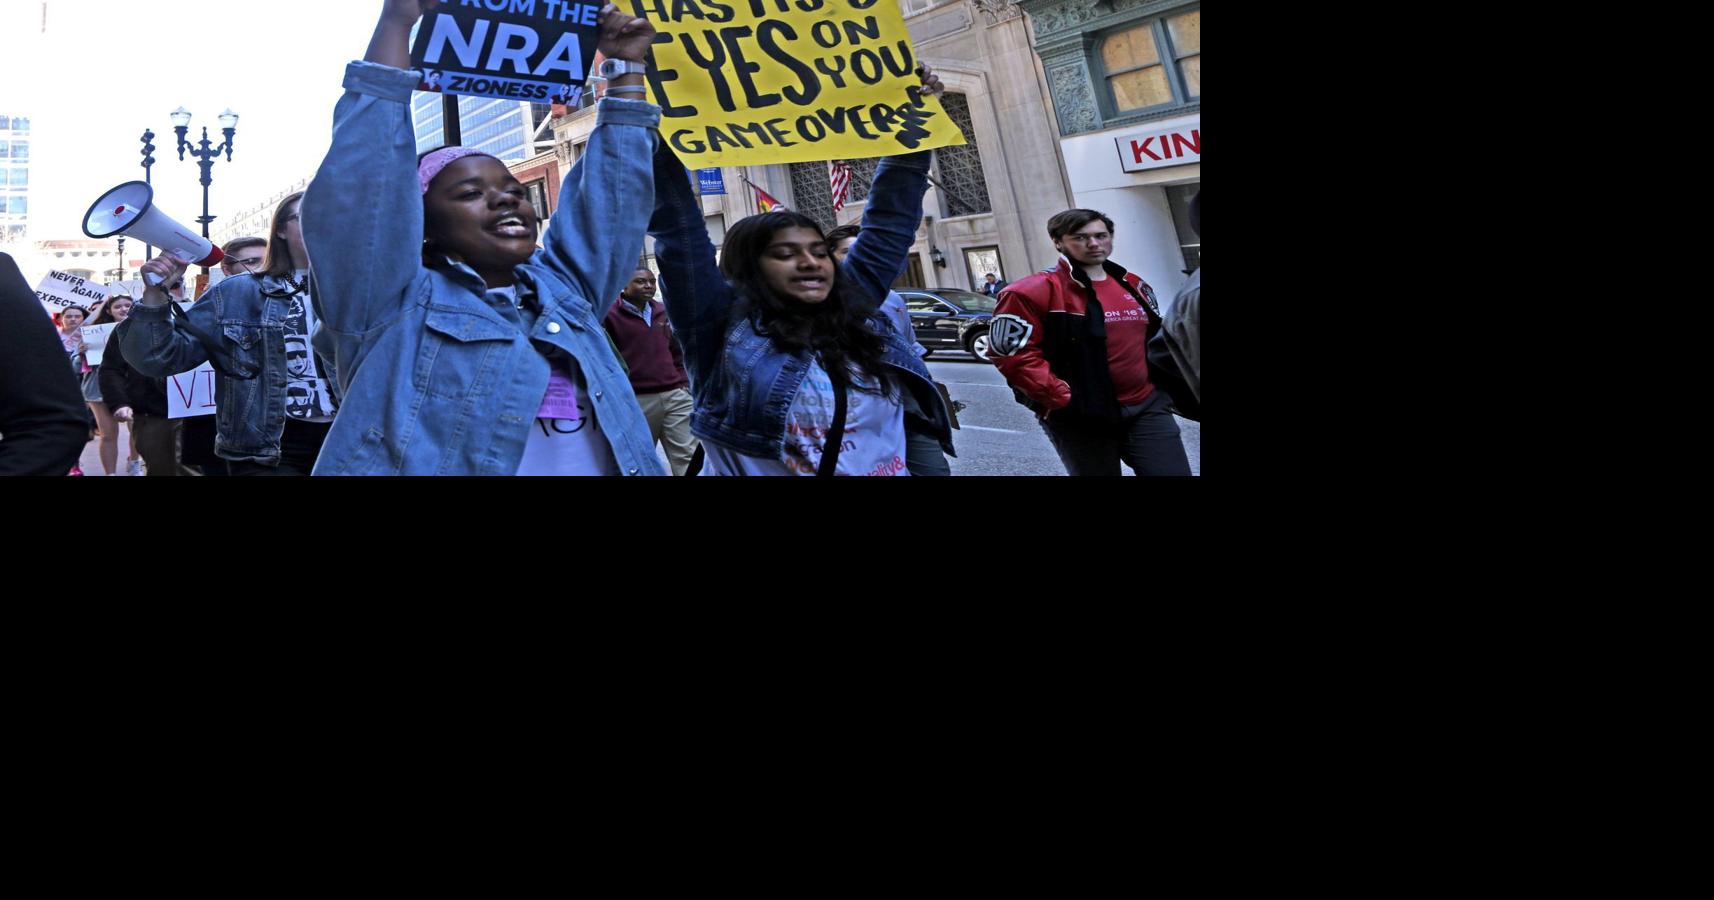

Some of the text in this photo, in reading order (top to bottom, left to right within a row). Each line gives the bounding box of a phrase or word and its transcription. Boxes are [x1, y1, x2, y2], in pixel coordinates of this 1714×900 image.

[440, 0, 599, 26] OM THE
[632, 0, 735, 22] HAS
[423, 13, 584, 81] NRA
[811, 15, 880, 48] ON
[645, 19, 822, 118] EYES
[814, 40, 914, 89] YOU
[447, 75, 549, 99] ZIONESS
[670, 102, 898, 154] GAME OVER
[1130, 129, 1200, 164] KIN
[50, 270, 85, 287] NEVER
[70, 285, 105, 301] AGAIN
